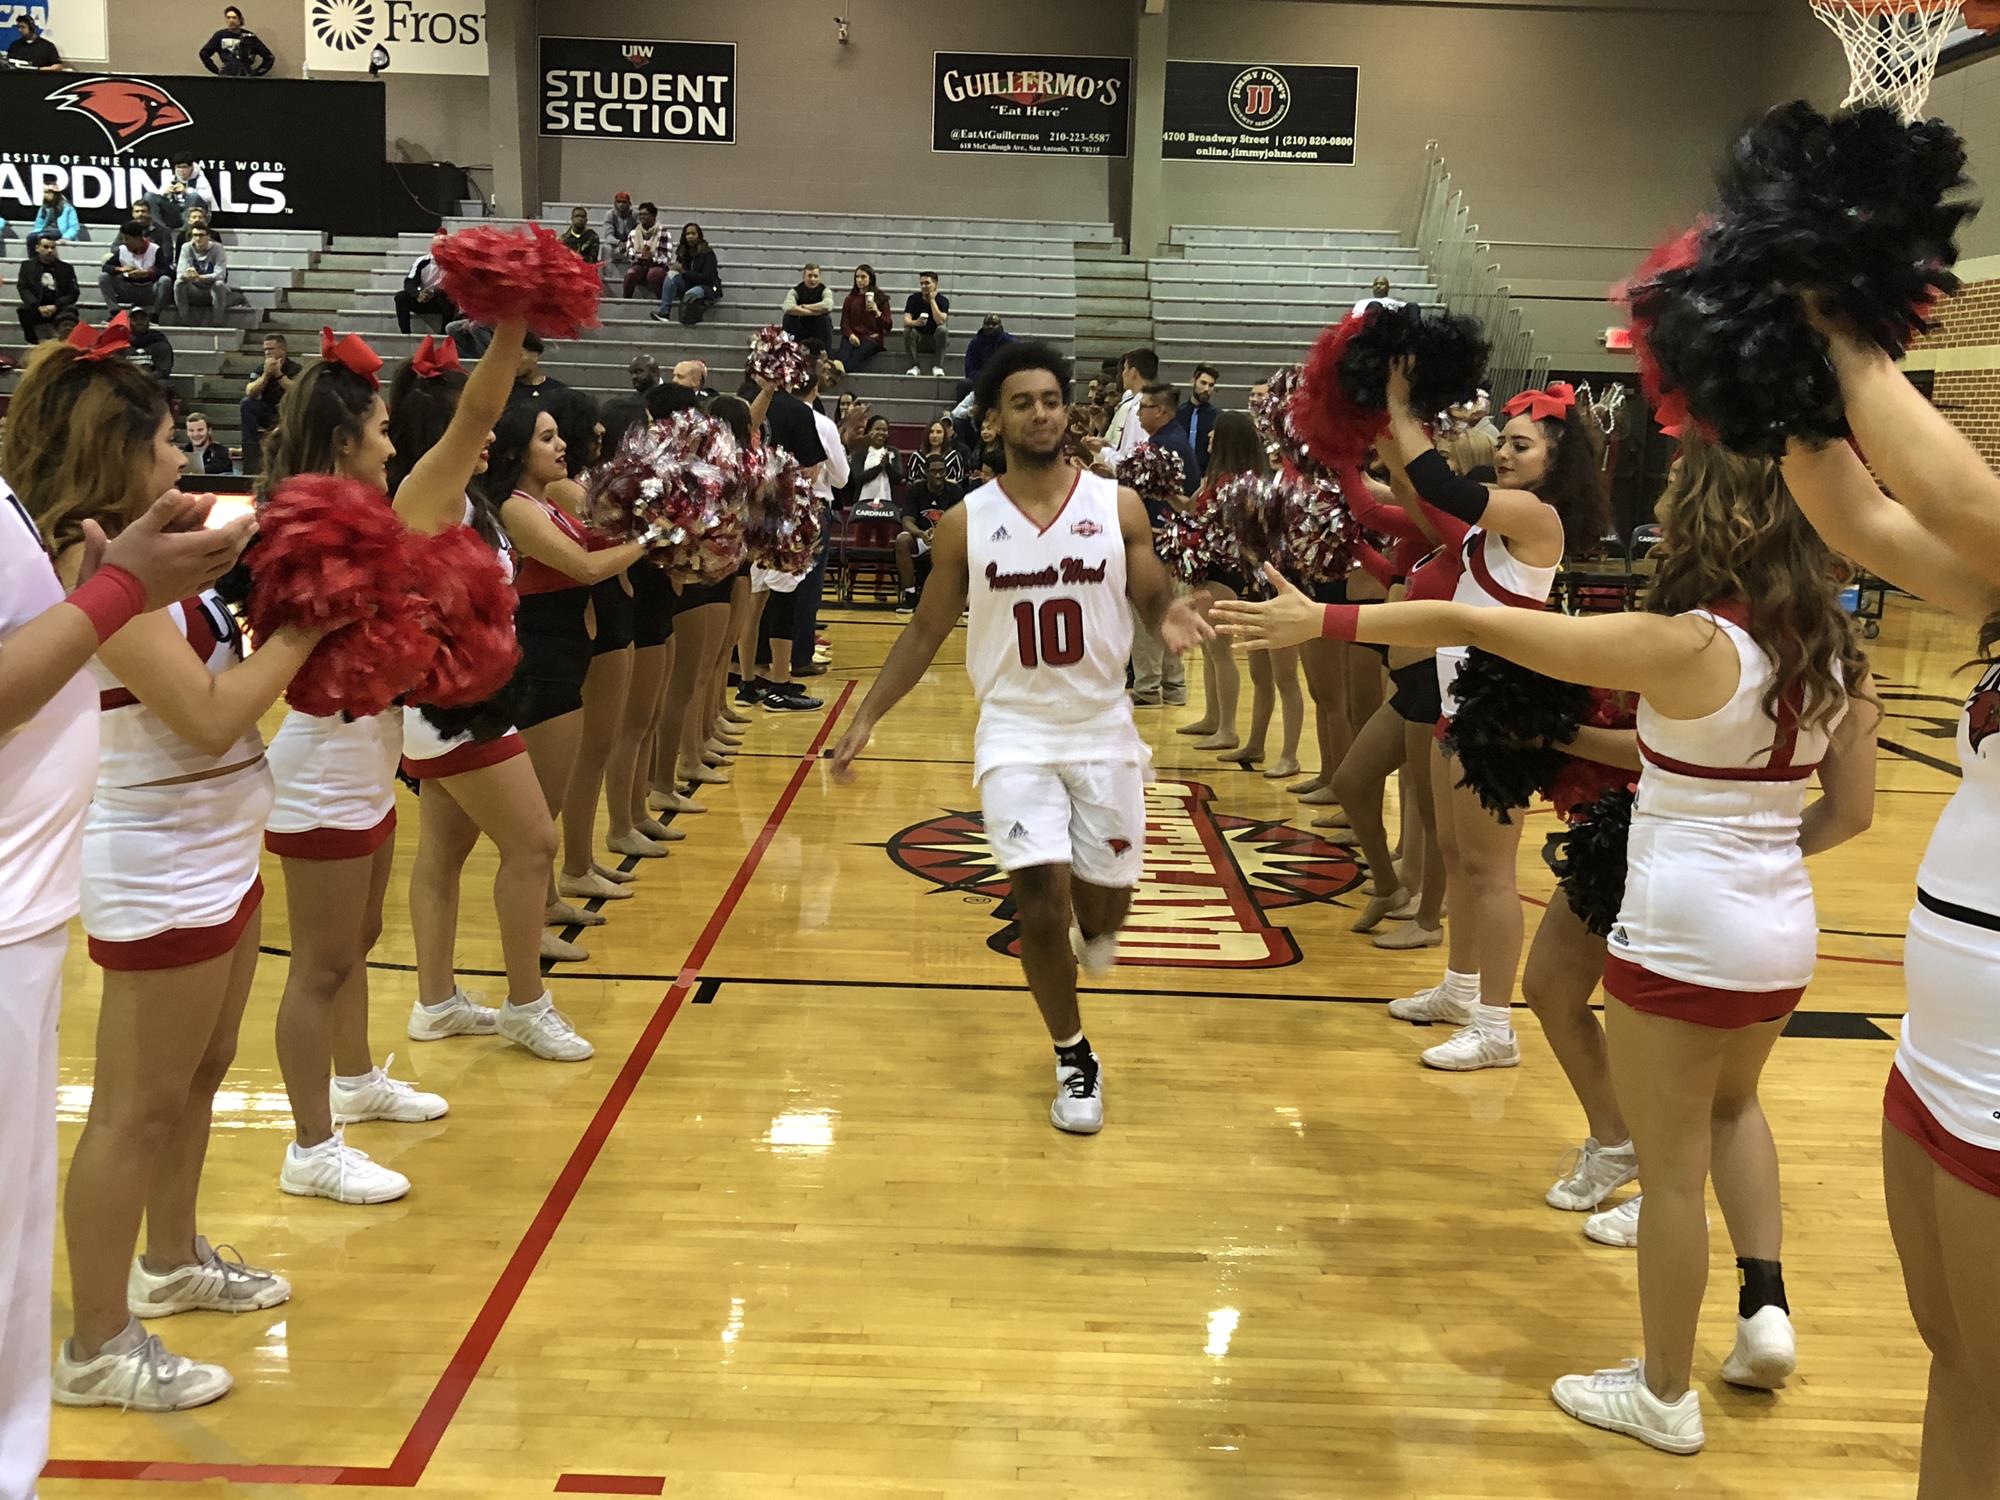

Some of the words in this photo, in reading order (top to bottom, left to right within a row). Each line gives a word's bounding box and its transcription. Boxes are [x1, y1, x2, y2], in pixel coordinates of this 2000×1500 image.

[384, 0, 487, 45] Fros
[621, 44, 654, 58] UIW
[545, 70, 729, 104] STUDENT
[943, 69, 1121, 106] GUILLERMO'S
[1232, 71, 1258, 99] JIMMY
[1261, 71, 1287, 101] JOHN'S
[1245, 85, 1274, 114] JJ
[545, 100, 726, 136] SECTION
[950, 128, 1039, 141] @EatAtGuillermos
[1049, 132, 1111, 143] 210-223-5587
[1162, 132, 1186, 142] 4700
[1188, 132, 1238, 145] Broadway
[1240, 134, 1269, 144] Street
[1282, 135, 1307, 146] (210)
[1309, 136, 1353, 146] 820-0800
[60, 155, 80, 165] OF
[89, 156, 120, 167] THE
[1195, 146, 1318, 160] online.jimmyjohns.com
[856, 509, 894, 517] CARDINALS
[1060, 556, 1107, 585] Word
[1013, 598, 1084, 669] 10
